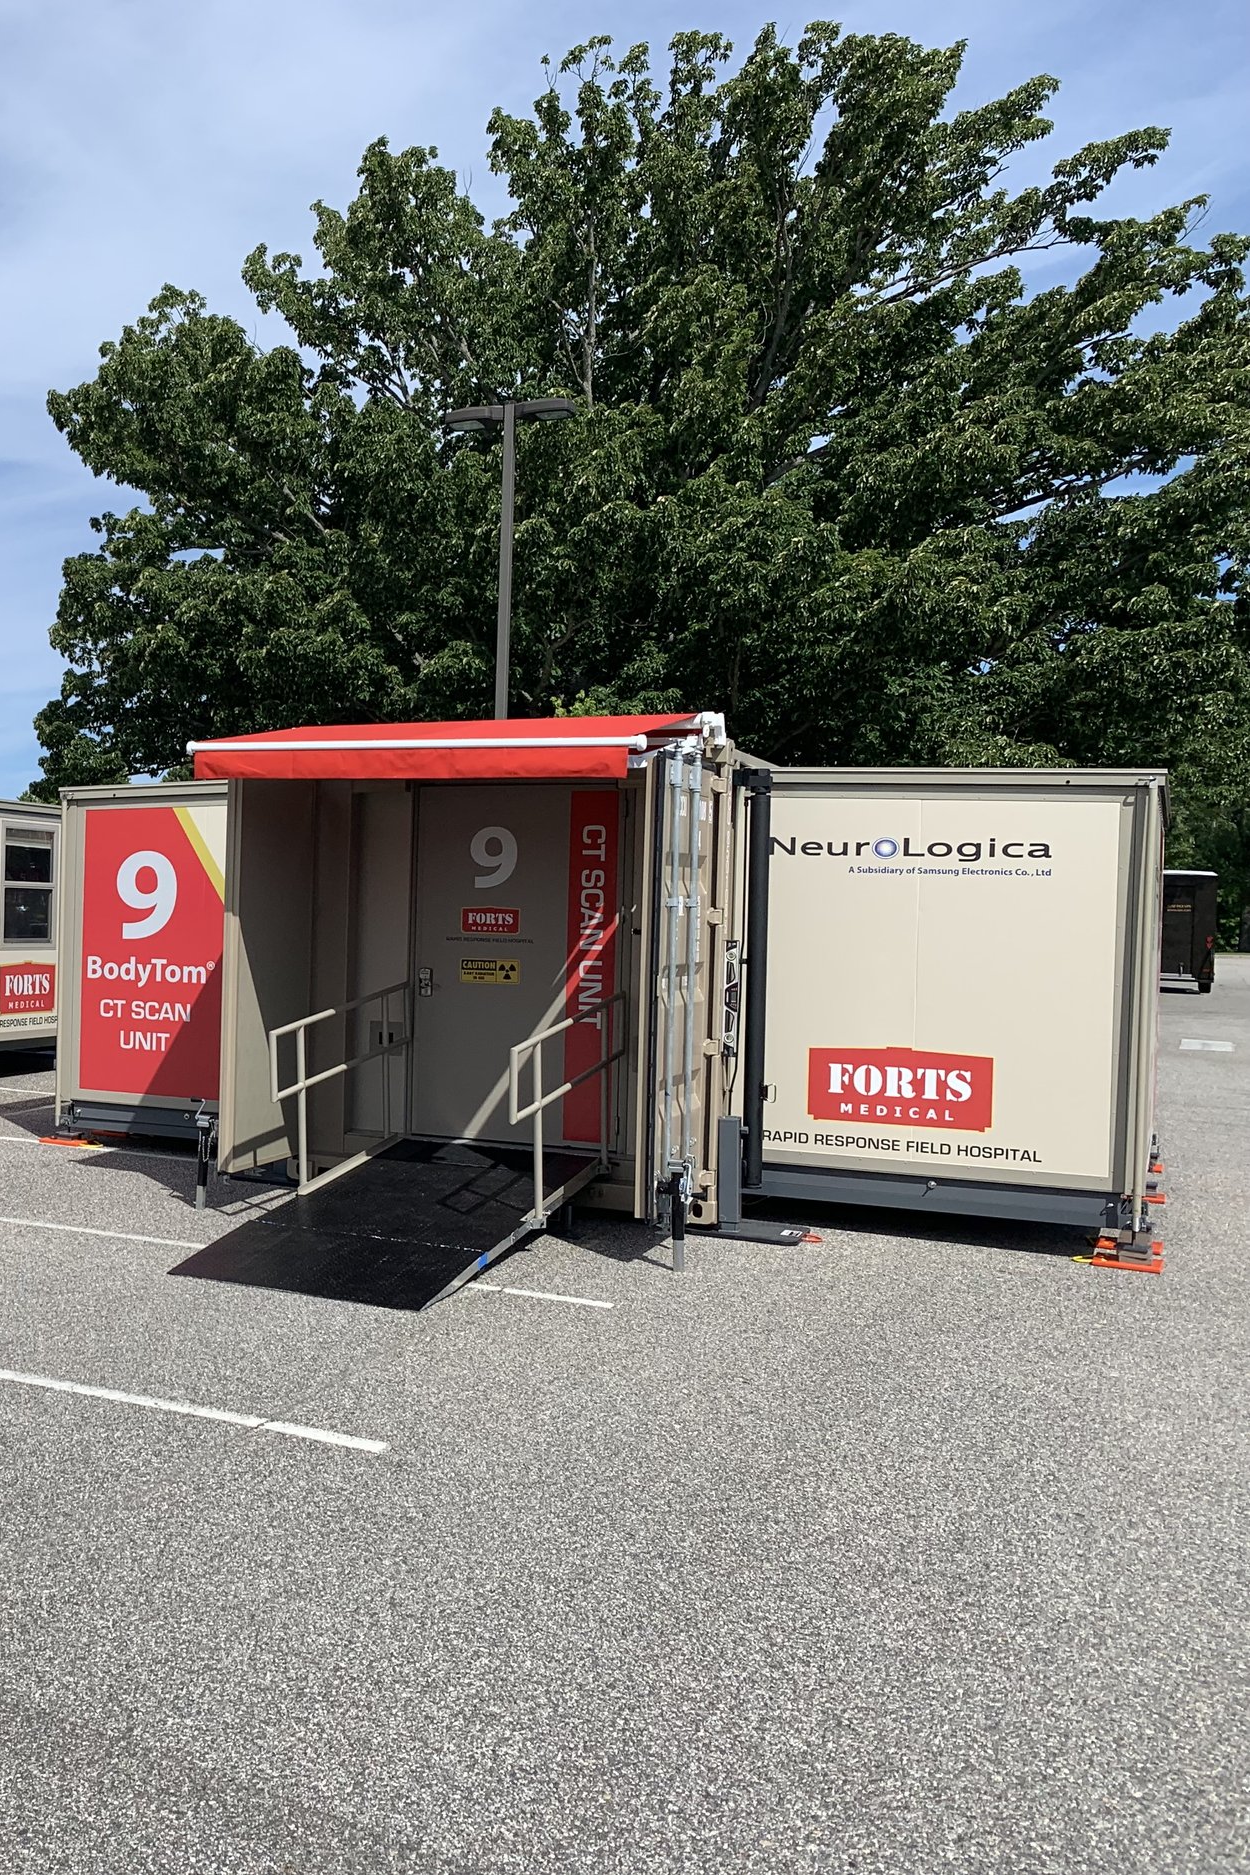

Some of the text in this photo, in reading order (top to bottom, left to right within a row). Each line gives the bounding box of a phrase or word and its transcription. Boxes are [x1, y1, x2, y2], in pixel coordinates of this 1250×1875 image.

[582, 825, 607, 861] CT
[470, 826, 518, 888] 9
[848, 866, 855, 874] A
[857, 866, 904, 876] Subsidiary
[906, 866, 916, 875] of
[917, 867, 960, 877] Samsung
[961, 867, 1013, 876] Electronics
[116, 850, 178, 940] 9
[467, 912, 514, 925] FORTS
[579, 869, 605, 951] SCAN
[462, 961, 496, 970] CAUTION
[4, 973, 50, 996] FORTS
[8, 999, 45, 1010] MEDICAL
[99, 998, 191, 1023] CT SCAN
[0, 1017, 28, 1028] RESPONSE
[28, 1016, 43, 1026] FIELD
[119, 1030, 170, 1052] UNIT
[827, 1062, 973, 1102] FORTS
[839, 1102, 955, 1121] MEDICAL
[762, 1129, 1043, 1163] RAPID RESPONSE FIELD HOSPITAL
